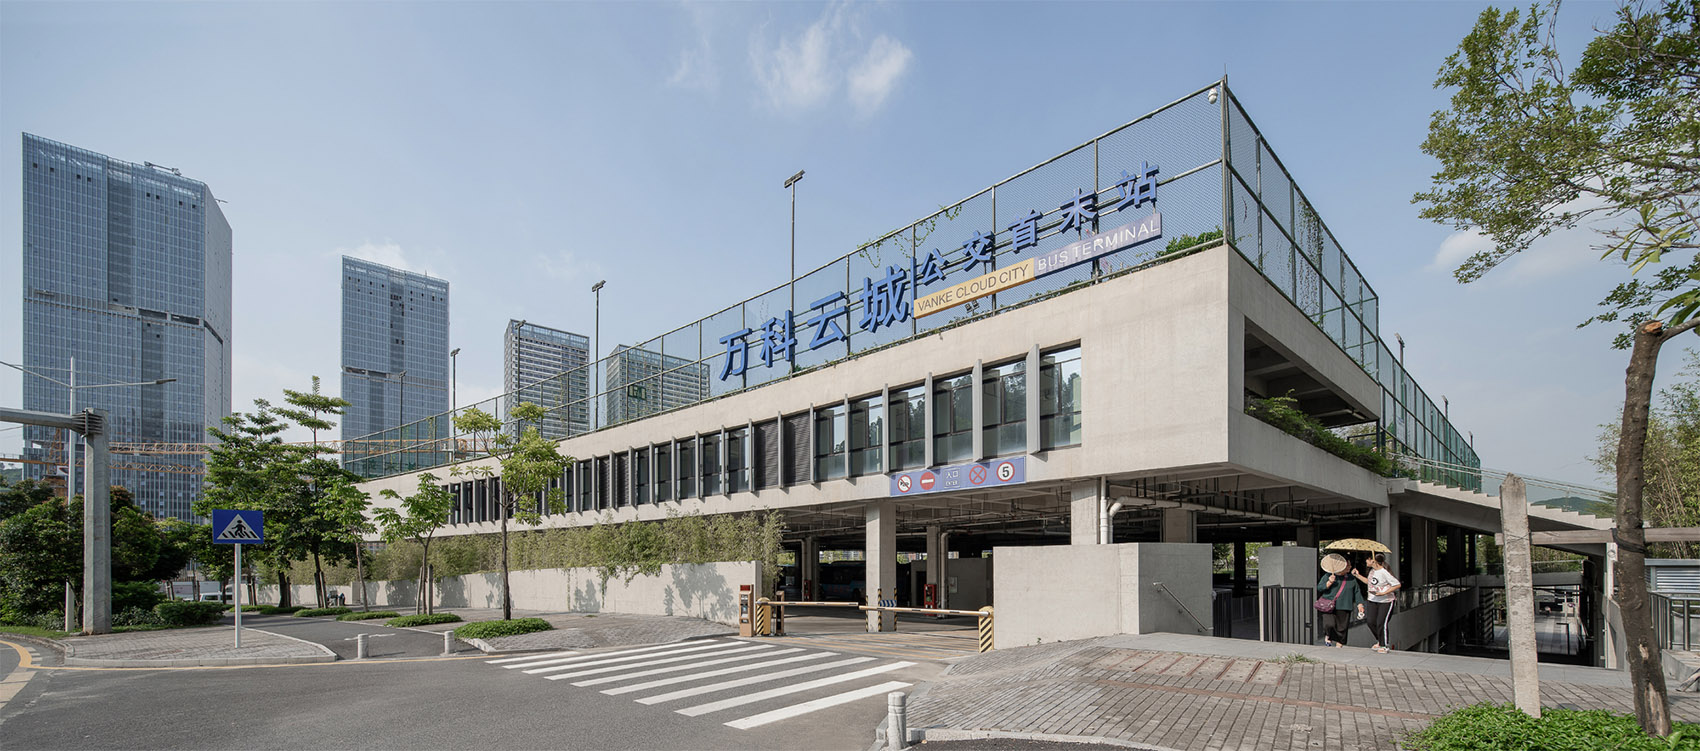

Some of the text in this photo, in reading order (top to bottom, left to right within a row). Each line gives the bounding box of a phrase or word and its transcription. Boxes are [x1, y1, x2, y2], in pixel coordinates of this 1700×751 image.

[1038, 219, 1159, 271] BUS TERMINAL
[719, 161, 1159, 381] 万科云城 公交首末站
[917, 263, 1029, 312] VANKE CLOUD CITY
[946, 470, 959, 478] 入口
[1002, 466, 1009, 478] 5
